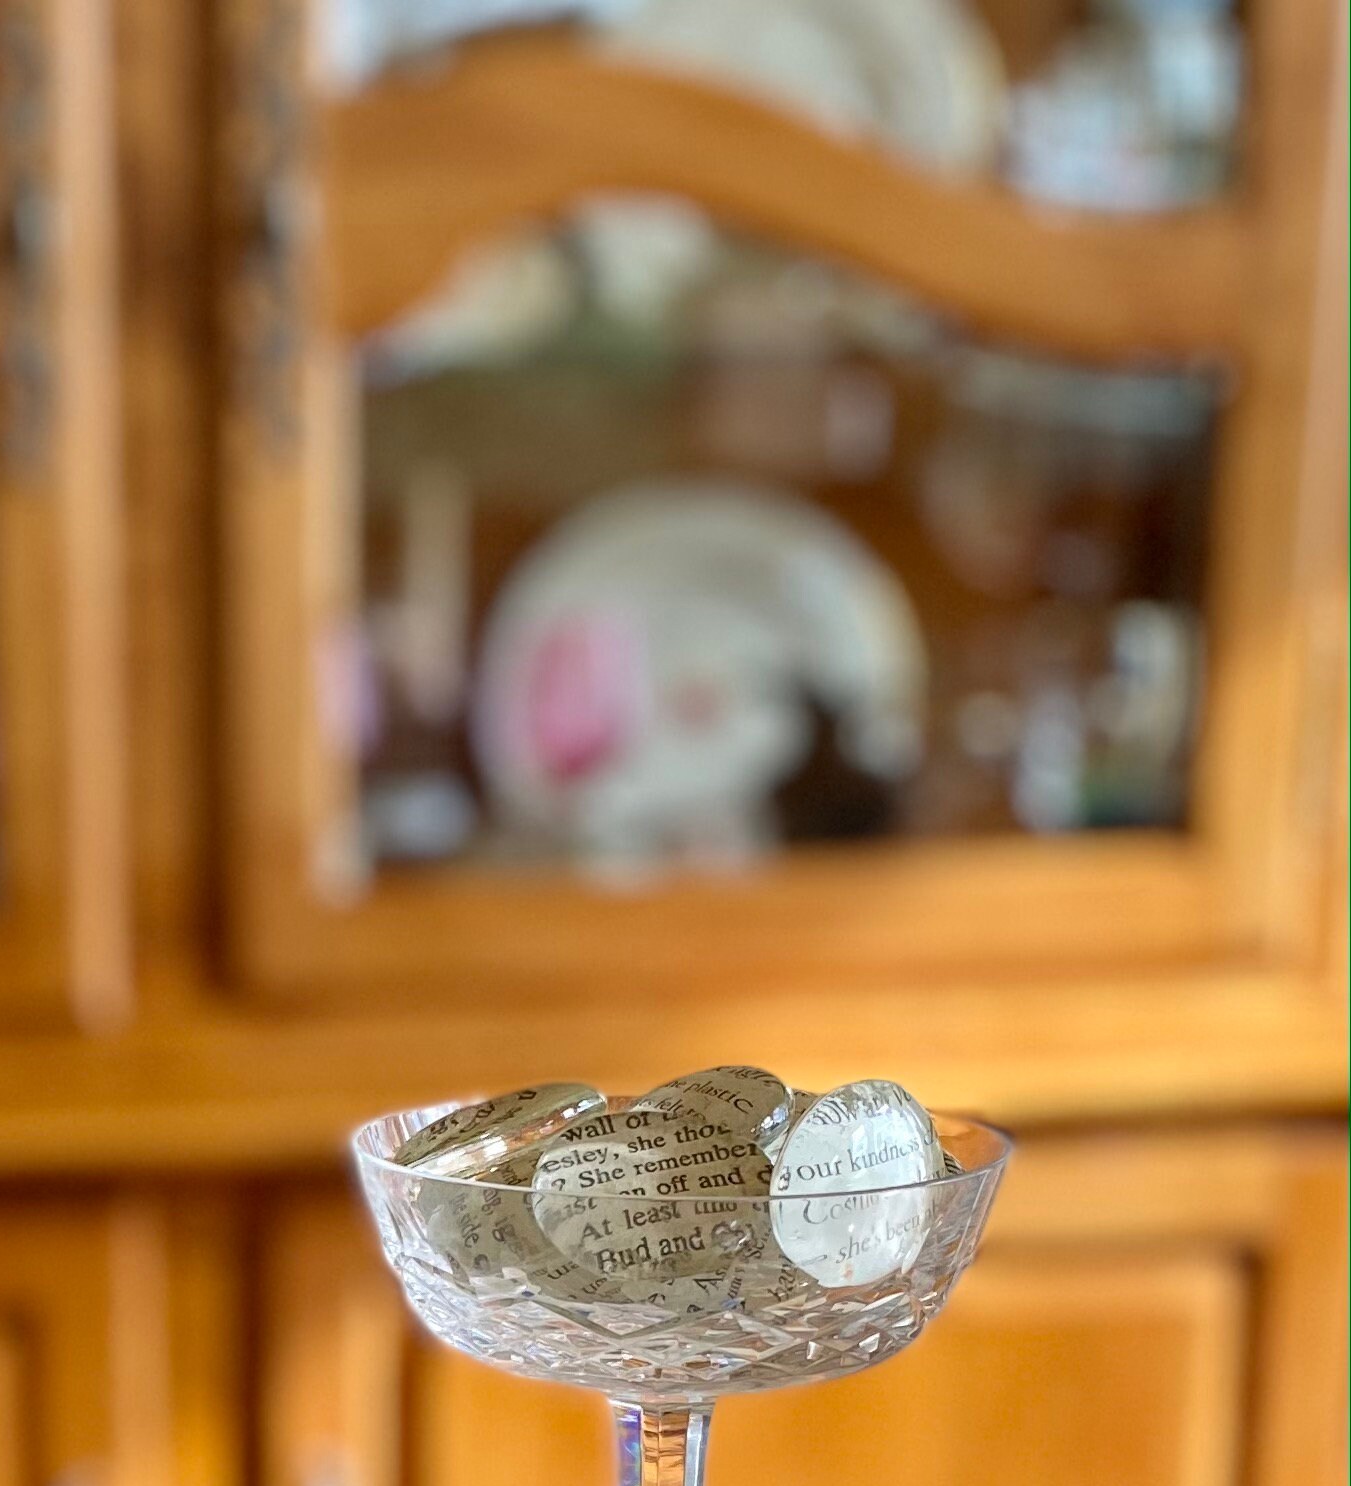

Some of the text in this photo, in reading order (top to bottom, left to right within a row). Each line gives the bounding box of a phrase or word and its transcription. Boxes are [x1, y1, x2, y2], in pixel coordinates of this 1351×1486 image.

[561, 1115, 616, 1142] wall
[627, 1133, 667, 1154] she
[847, 1137, 920, 1172] kindness
[579, 1165, 626, 1188] She
[656, 1174, 689, 1196] off
[698, 1167, 746, 1188] and
[581, 1219, 613, 1243] At
[658, 1226, 705, 1257] and
